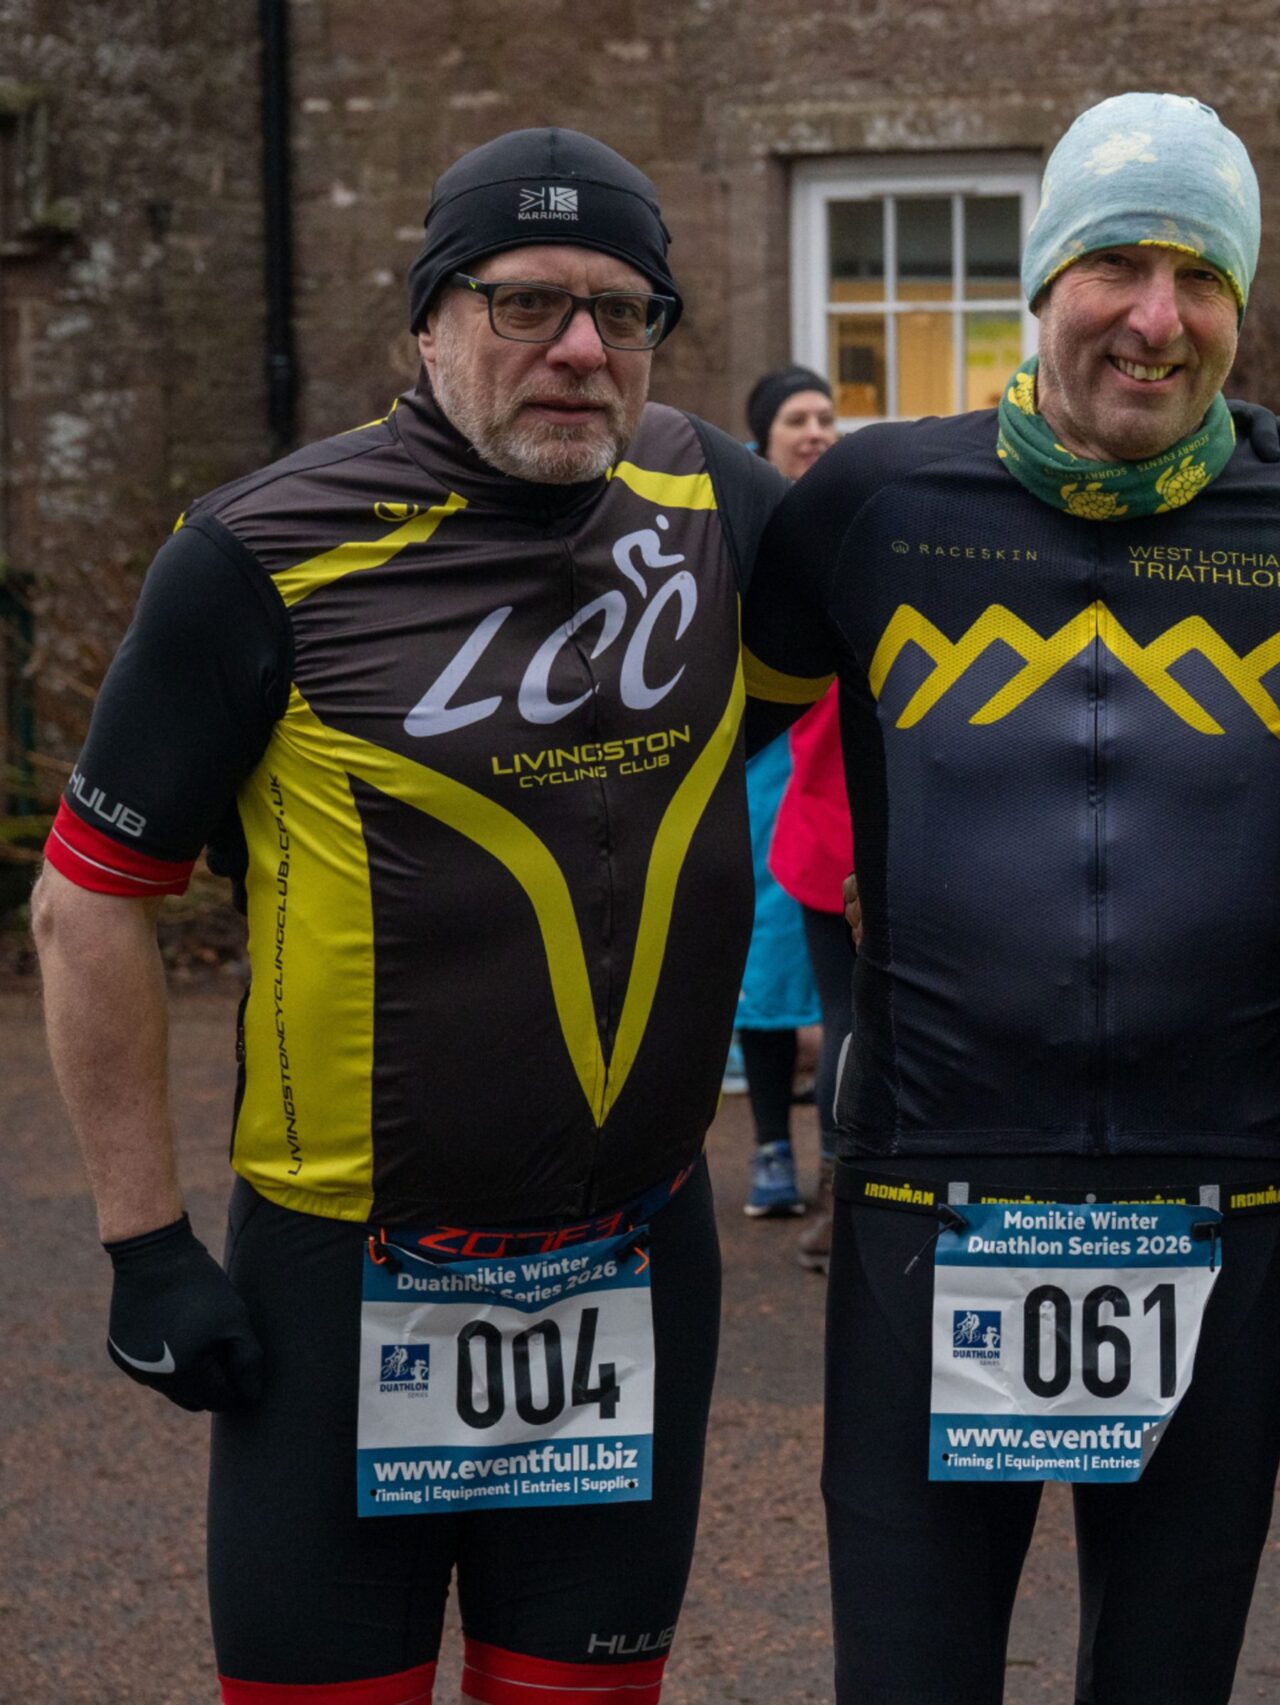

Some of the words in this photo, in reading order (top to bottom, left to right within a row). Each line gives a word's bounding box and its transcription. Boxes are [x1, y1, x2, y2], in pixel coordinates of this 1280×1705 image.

[518, 211, 579, 221] KARRIMOR
[919, 543, 1038, 561] RACESKIN
[1129, 546, 1190, 562] WEST
[403, 570, 698, 738] LCC
[491, 725, 691, 776] LIVINGSTON
[519, 766, 607, 788] CYCLING
[619, 754, 670, 775] CLUB
[69, 764, 147, 838] HUUB
[865, 1182, 934, 1206] IRONMAN
[1003, 1211, 1087, 1231] Monikie
[1090, 1211, 1158, 1231] Winter
[967, 1236, 1063, 1256] Duathlon
[1068, 1236, 1131, 1256] Series
[1135, 1236, 1192, 1255] 2026
[397, 1272, 496, 1294] Duathl
[565, 1261, 618, 1290] 2026
[465, 1265, 516, 1286] nikie
[521, 1255, 589, 1282] Winter
[1023, 1283, 1177, 1398] 061
[953, 1350, 1000, 1359] DUATHLON
[456, 1307, 620, 1430] 004
[380, 1382, 429, 1392] DUATHLON
[946, 1422, 1157, 1449] www.eventfu
[373, 1442, 638, 1483] www.eventfull.biz
[947, 1453, 994, 1470] Timing
[1005, 1454, 1080, 1471] Equipment
[1091, 1456, 1140, 1469] Entries
[374, 1488, 422, 1504] Timing
[433, 1482, 511, 1501] Equipment
[522, 1478, 570, 1494] Entries
